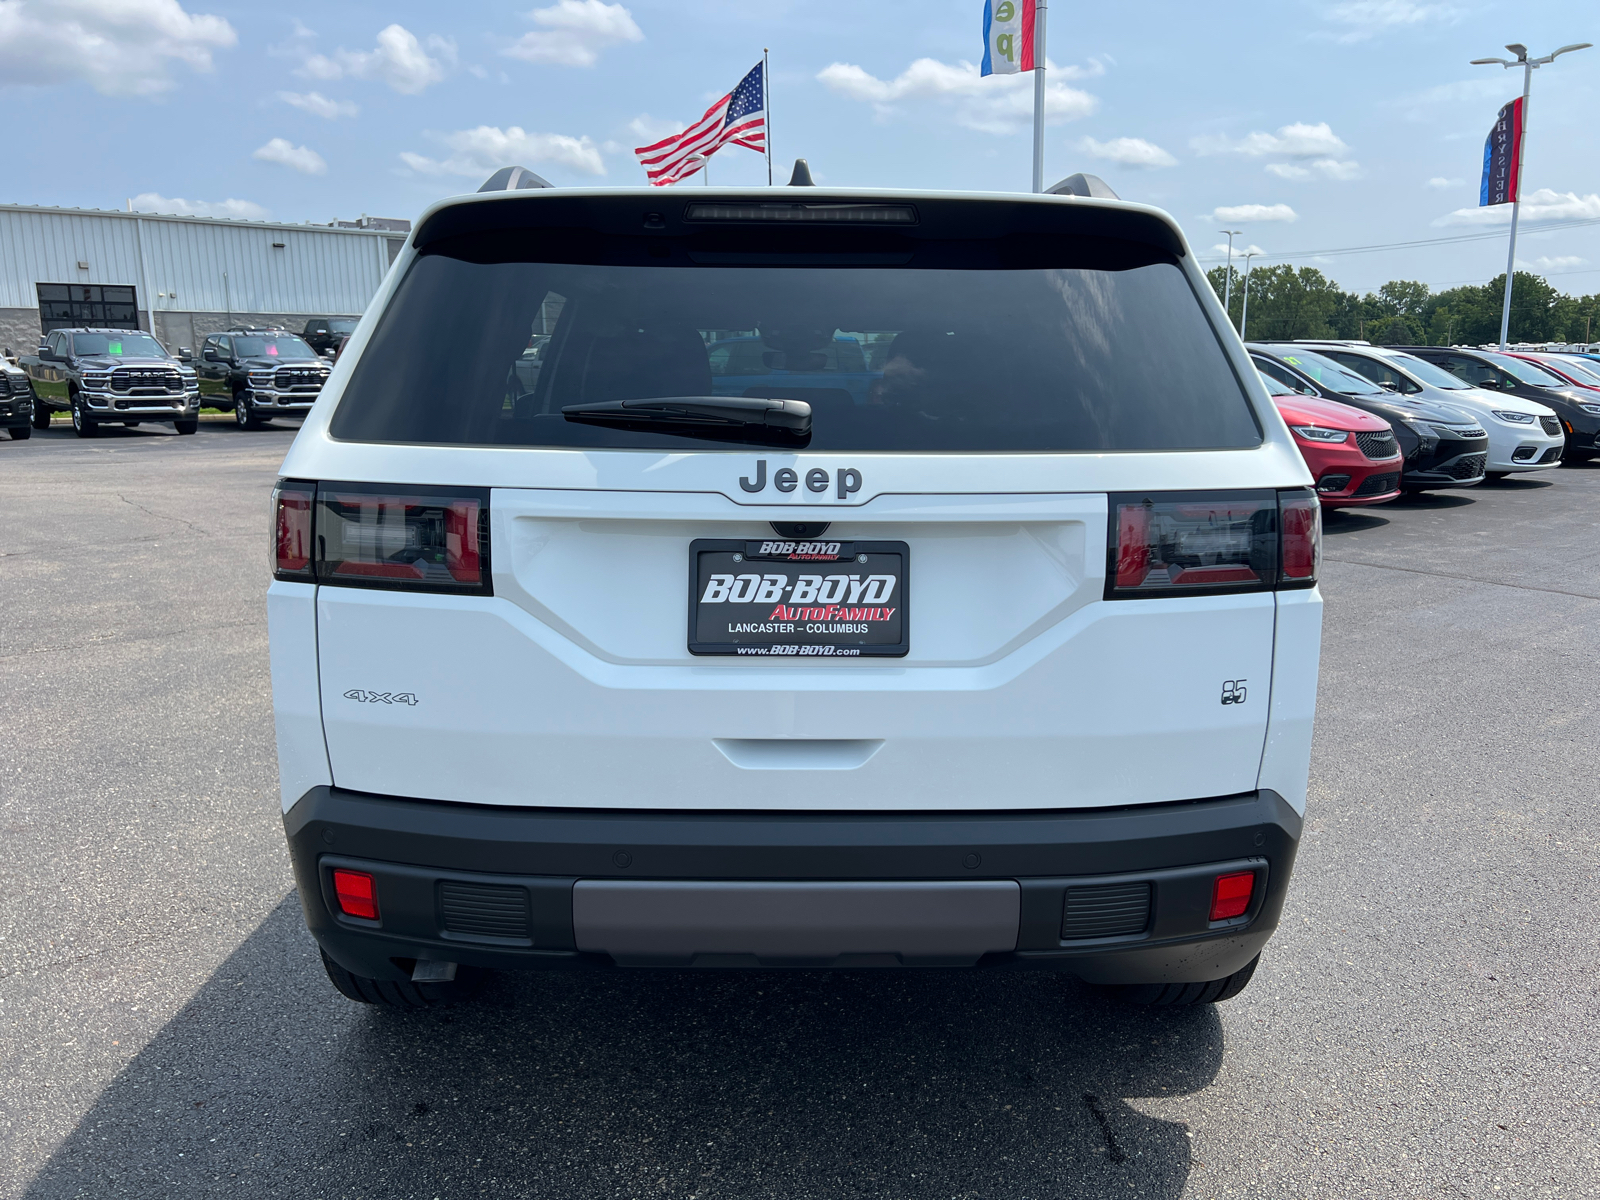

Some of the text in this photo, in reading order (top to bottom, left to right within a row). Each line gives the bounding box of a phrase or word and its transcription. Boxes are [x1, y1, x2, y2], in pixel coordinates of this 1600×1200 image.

[739, 459, 863, 499] Jeep
[700, 574, 897, 604] BOB-BOYD
[728, 623, 794, 633] LANCASTER
[806, 623, 868, 634] COLUMBUS
